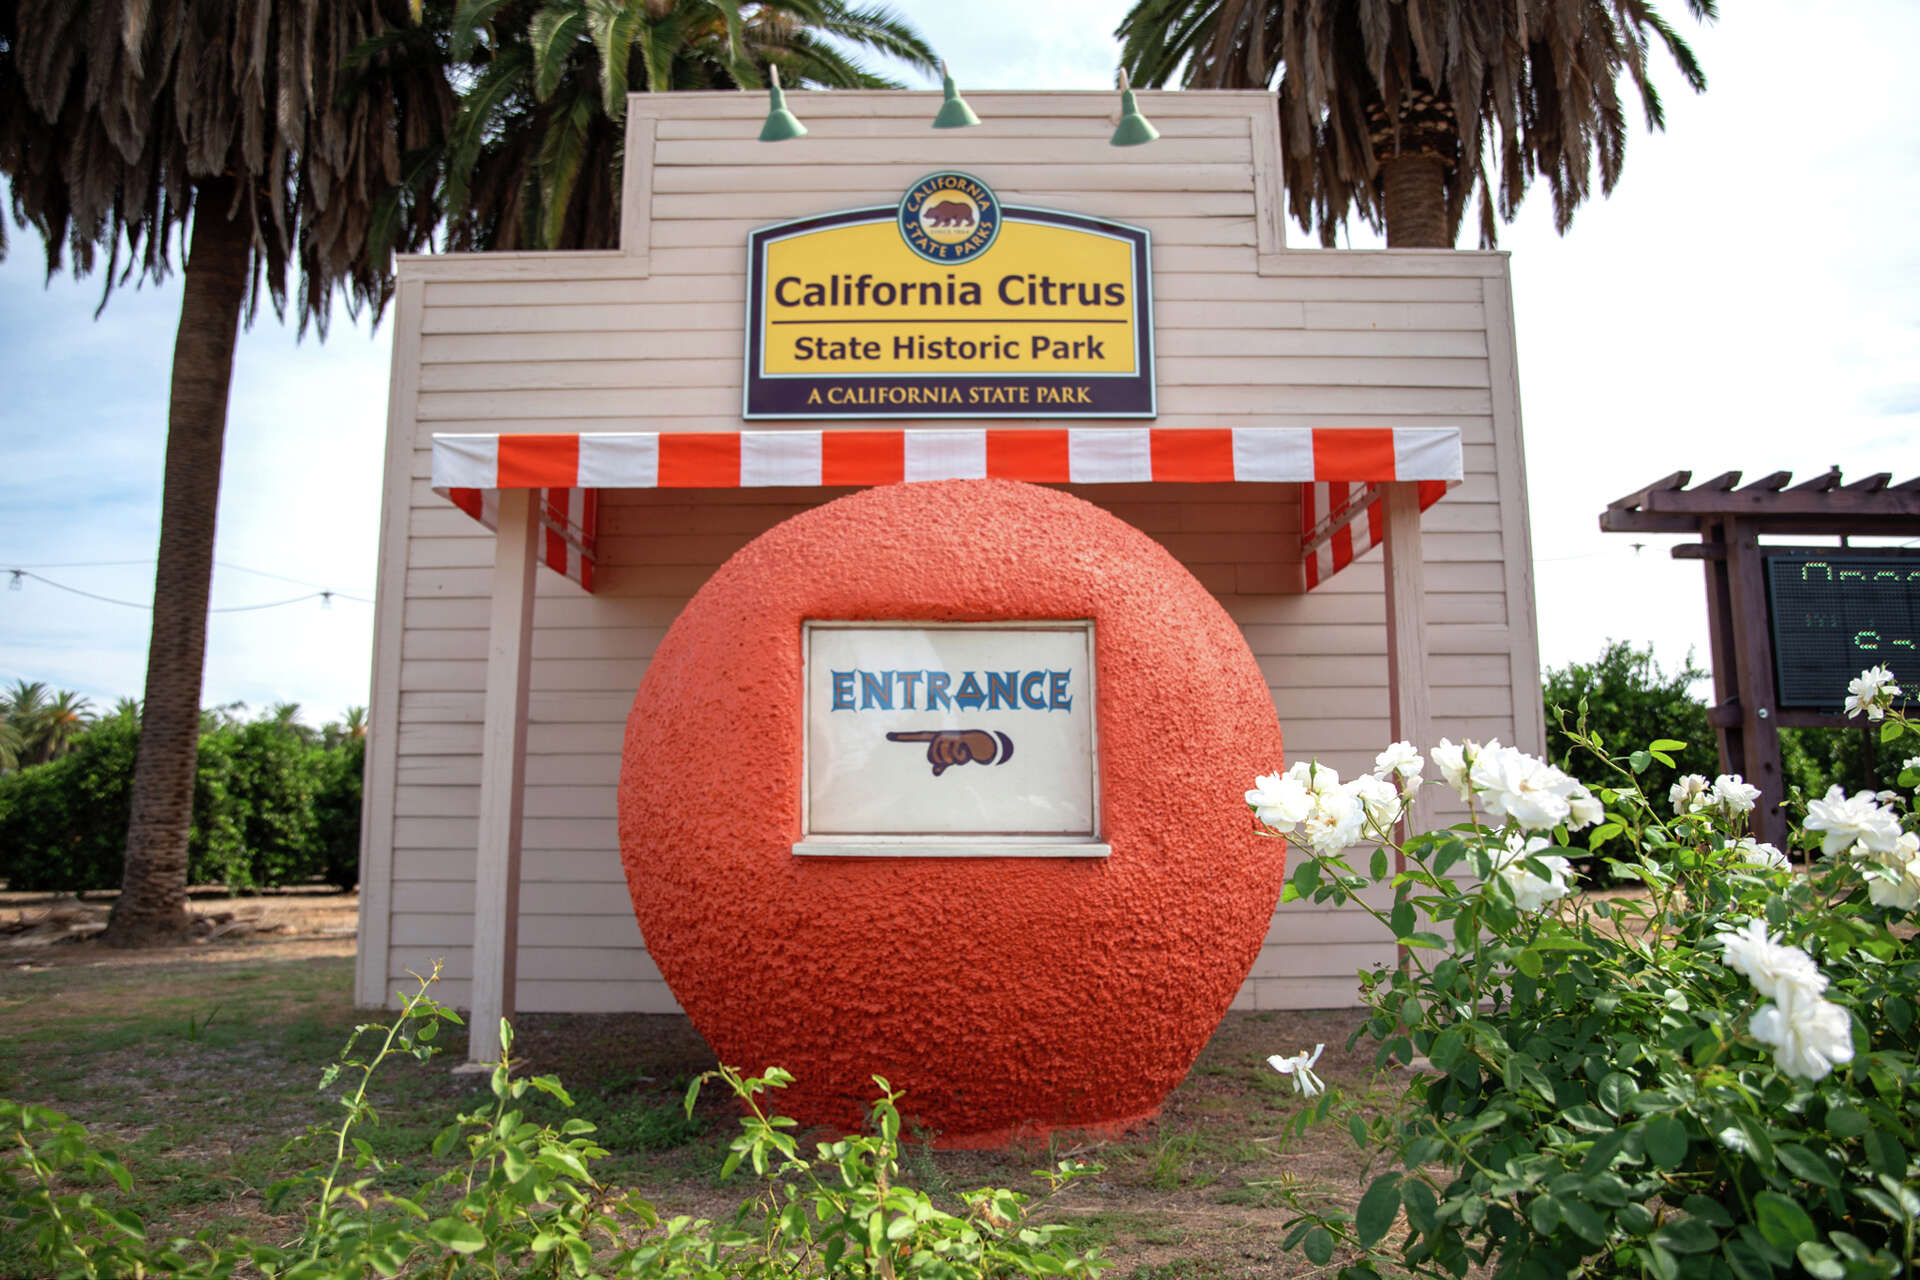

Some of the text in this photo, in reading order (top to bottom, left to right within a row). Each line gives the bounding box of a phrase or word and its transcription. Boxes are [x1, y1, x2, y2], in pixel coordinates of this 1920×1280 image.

[907, 176, 991, 212] CALIFORNIA
[906, 221, 993, 257] STATE PARKS
[775, 274, 1126, 307] California Citrus
[794, 335, 1106, 360] State Historic Park
[807, 386, 1093, 405] A CALIFORNIA STATE PARK
[830, 668, 1074, 714] ENTRANCE
